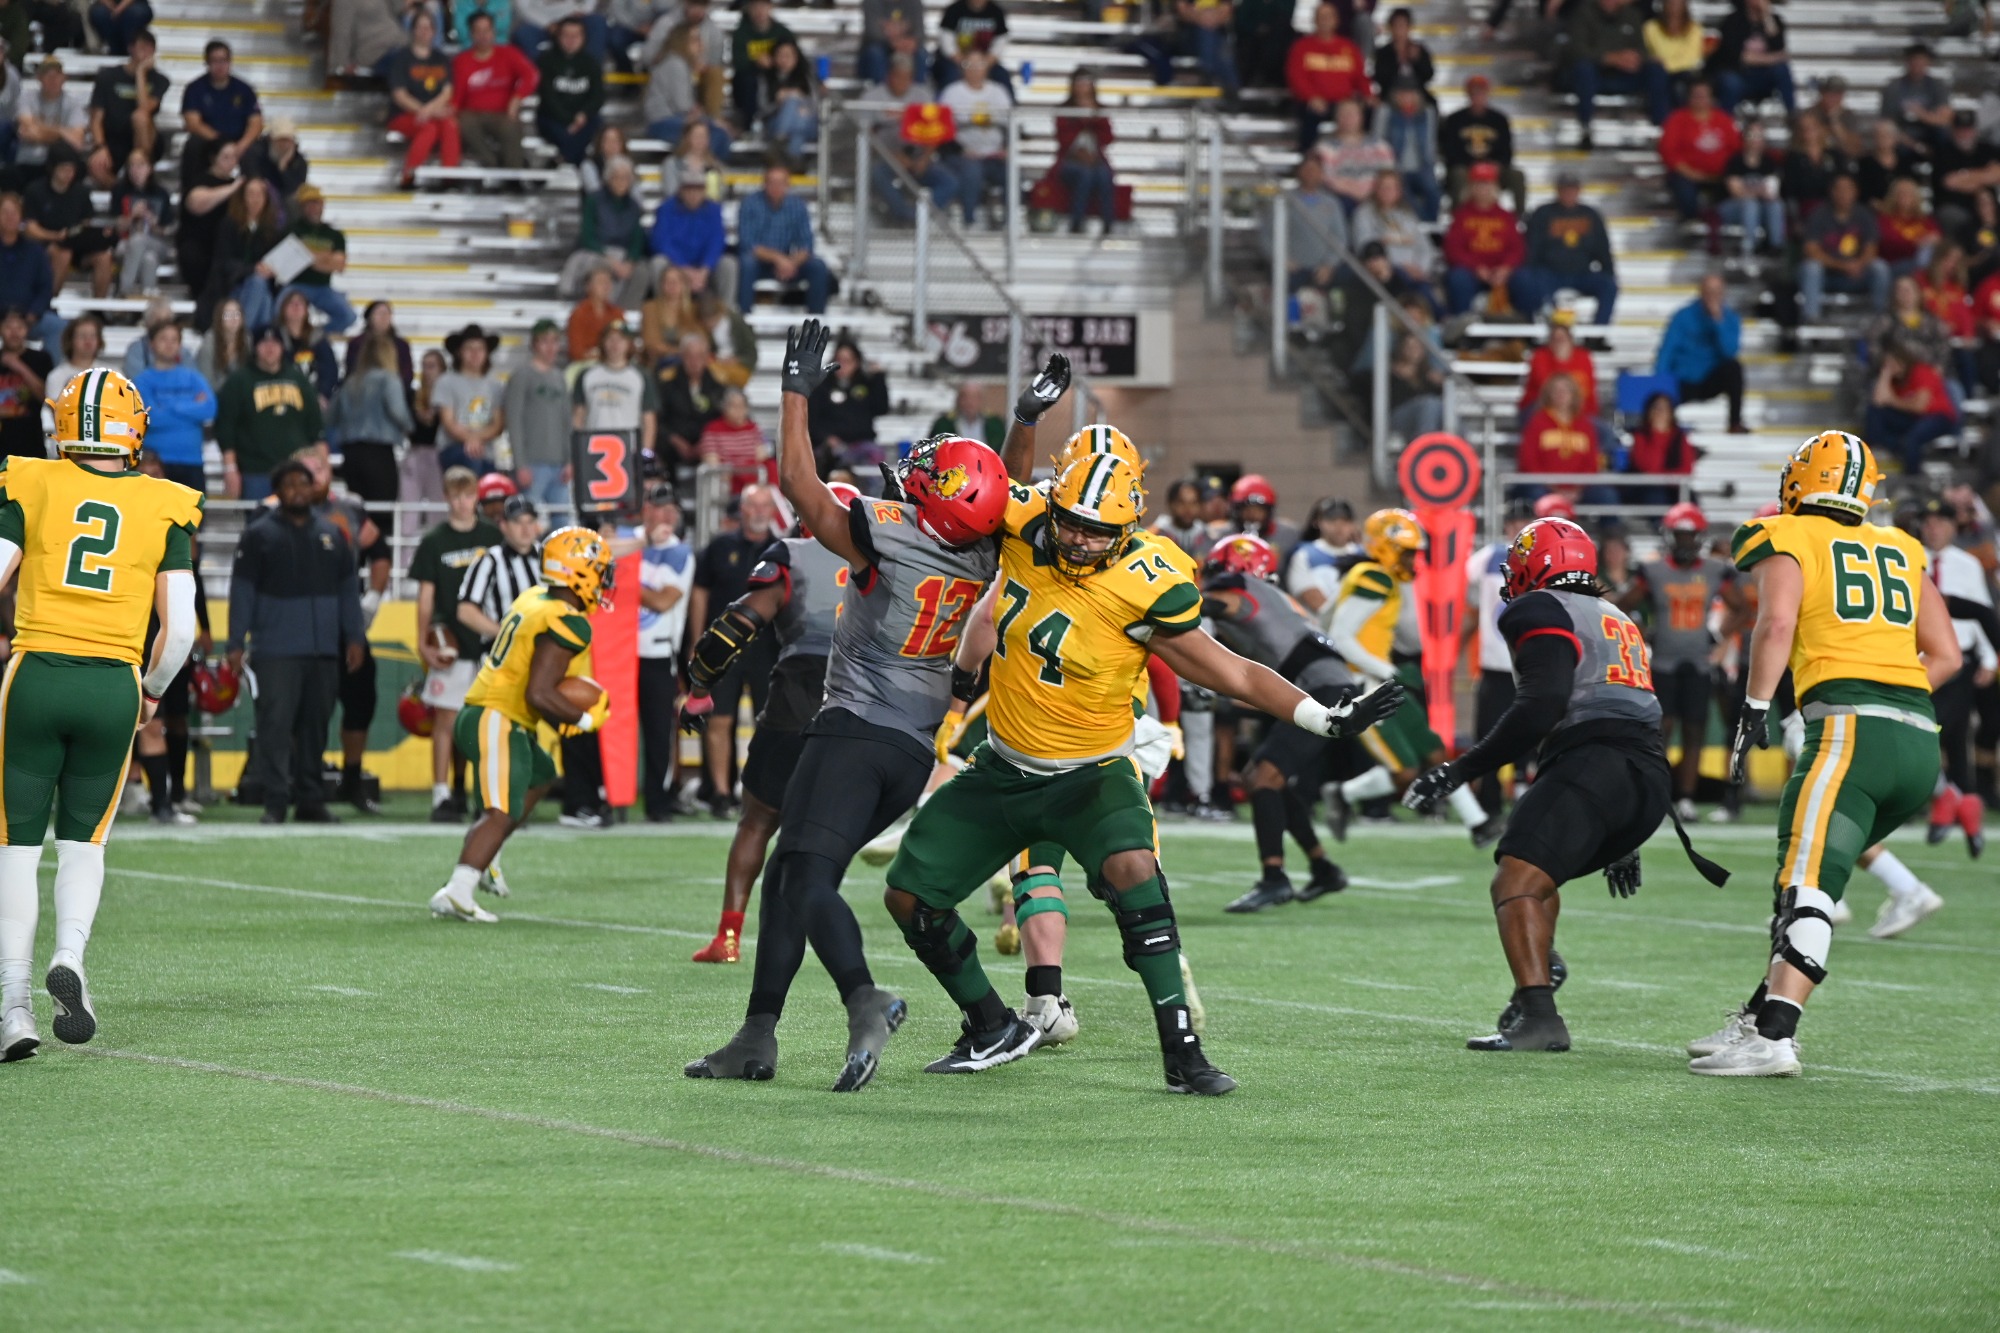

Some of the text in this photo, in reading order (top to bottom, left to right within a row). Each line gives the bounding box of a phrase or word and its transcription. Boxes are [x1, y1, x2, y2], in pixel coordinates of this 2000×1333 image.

[981, 317, 1074, 344] SPRTS
[84, 404, 93, 439] CATS
[588, 434, 629, 499] 3
[62, 499, 122, 594] 2
[872, 501, 903, 524] 12
[1125, 553, 1180, 584] 74
[1831, 538, 1915, 628] 66
[899, 575, 985, 659] 12
[994, 577, 1074, 688] 74
[1601, 613, 1656, 692] 33
